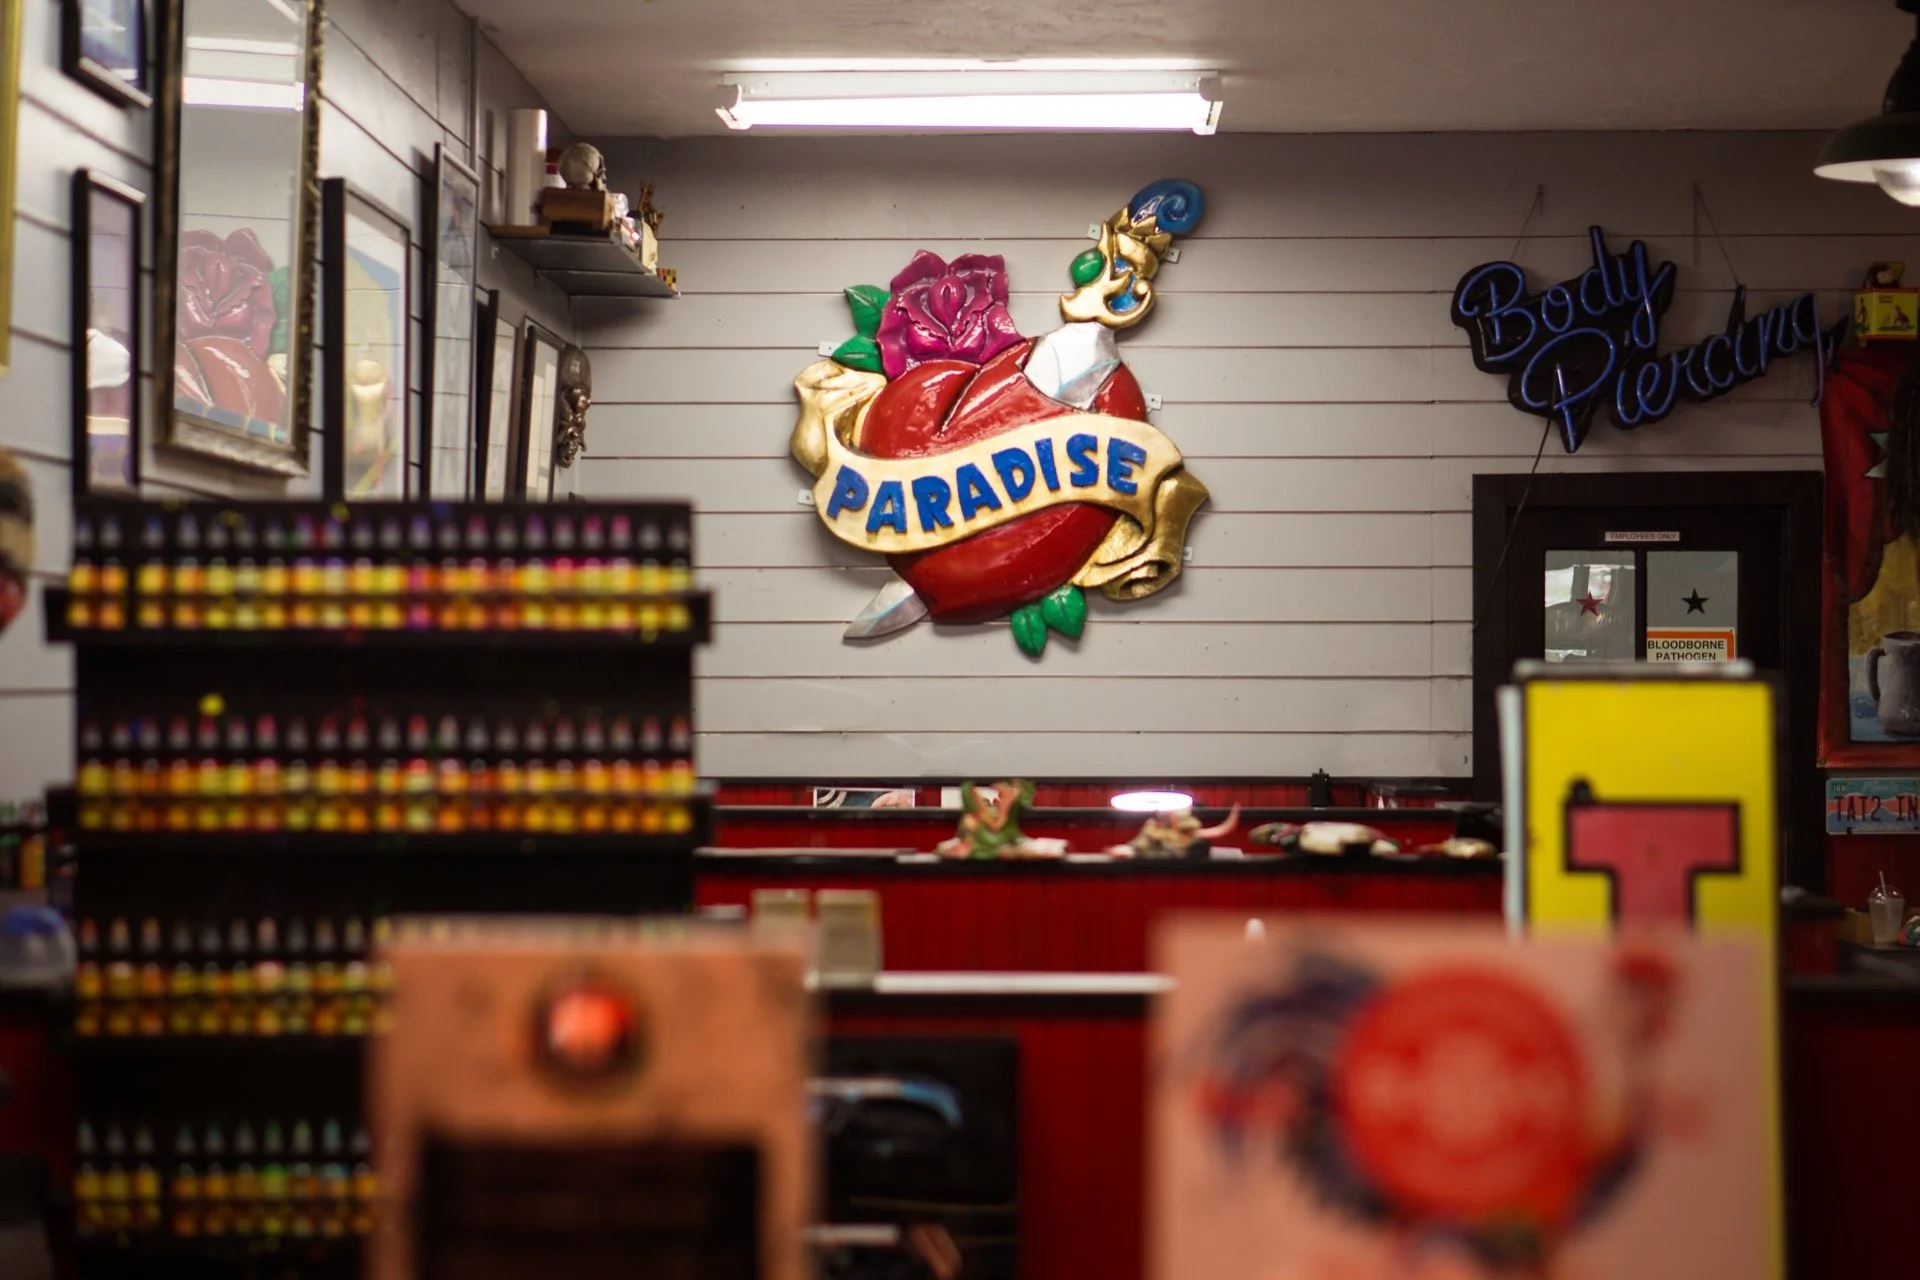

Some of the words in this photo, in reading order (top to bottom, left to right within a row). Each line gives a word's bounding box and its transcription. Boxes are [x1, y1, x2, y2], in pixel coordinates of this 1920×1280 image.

[1459, 226, 1674, 362] Body
[1520, 286, 1834, 454] Piercing
[826, 432, 1147, 534] PARADISE
[1647, 640, 1725, 650] BLOODBORNE
[1656, 652, 1716, 661] PATHOGEN
[1835, 795, 1881, 821] TAT2
